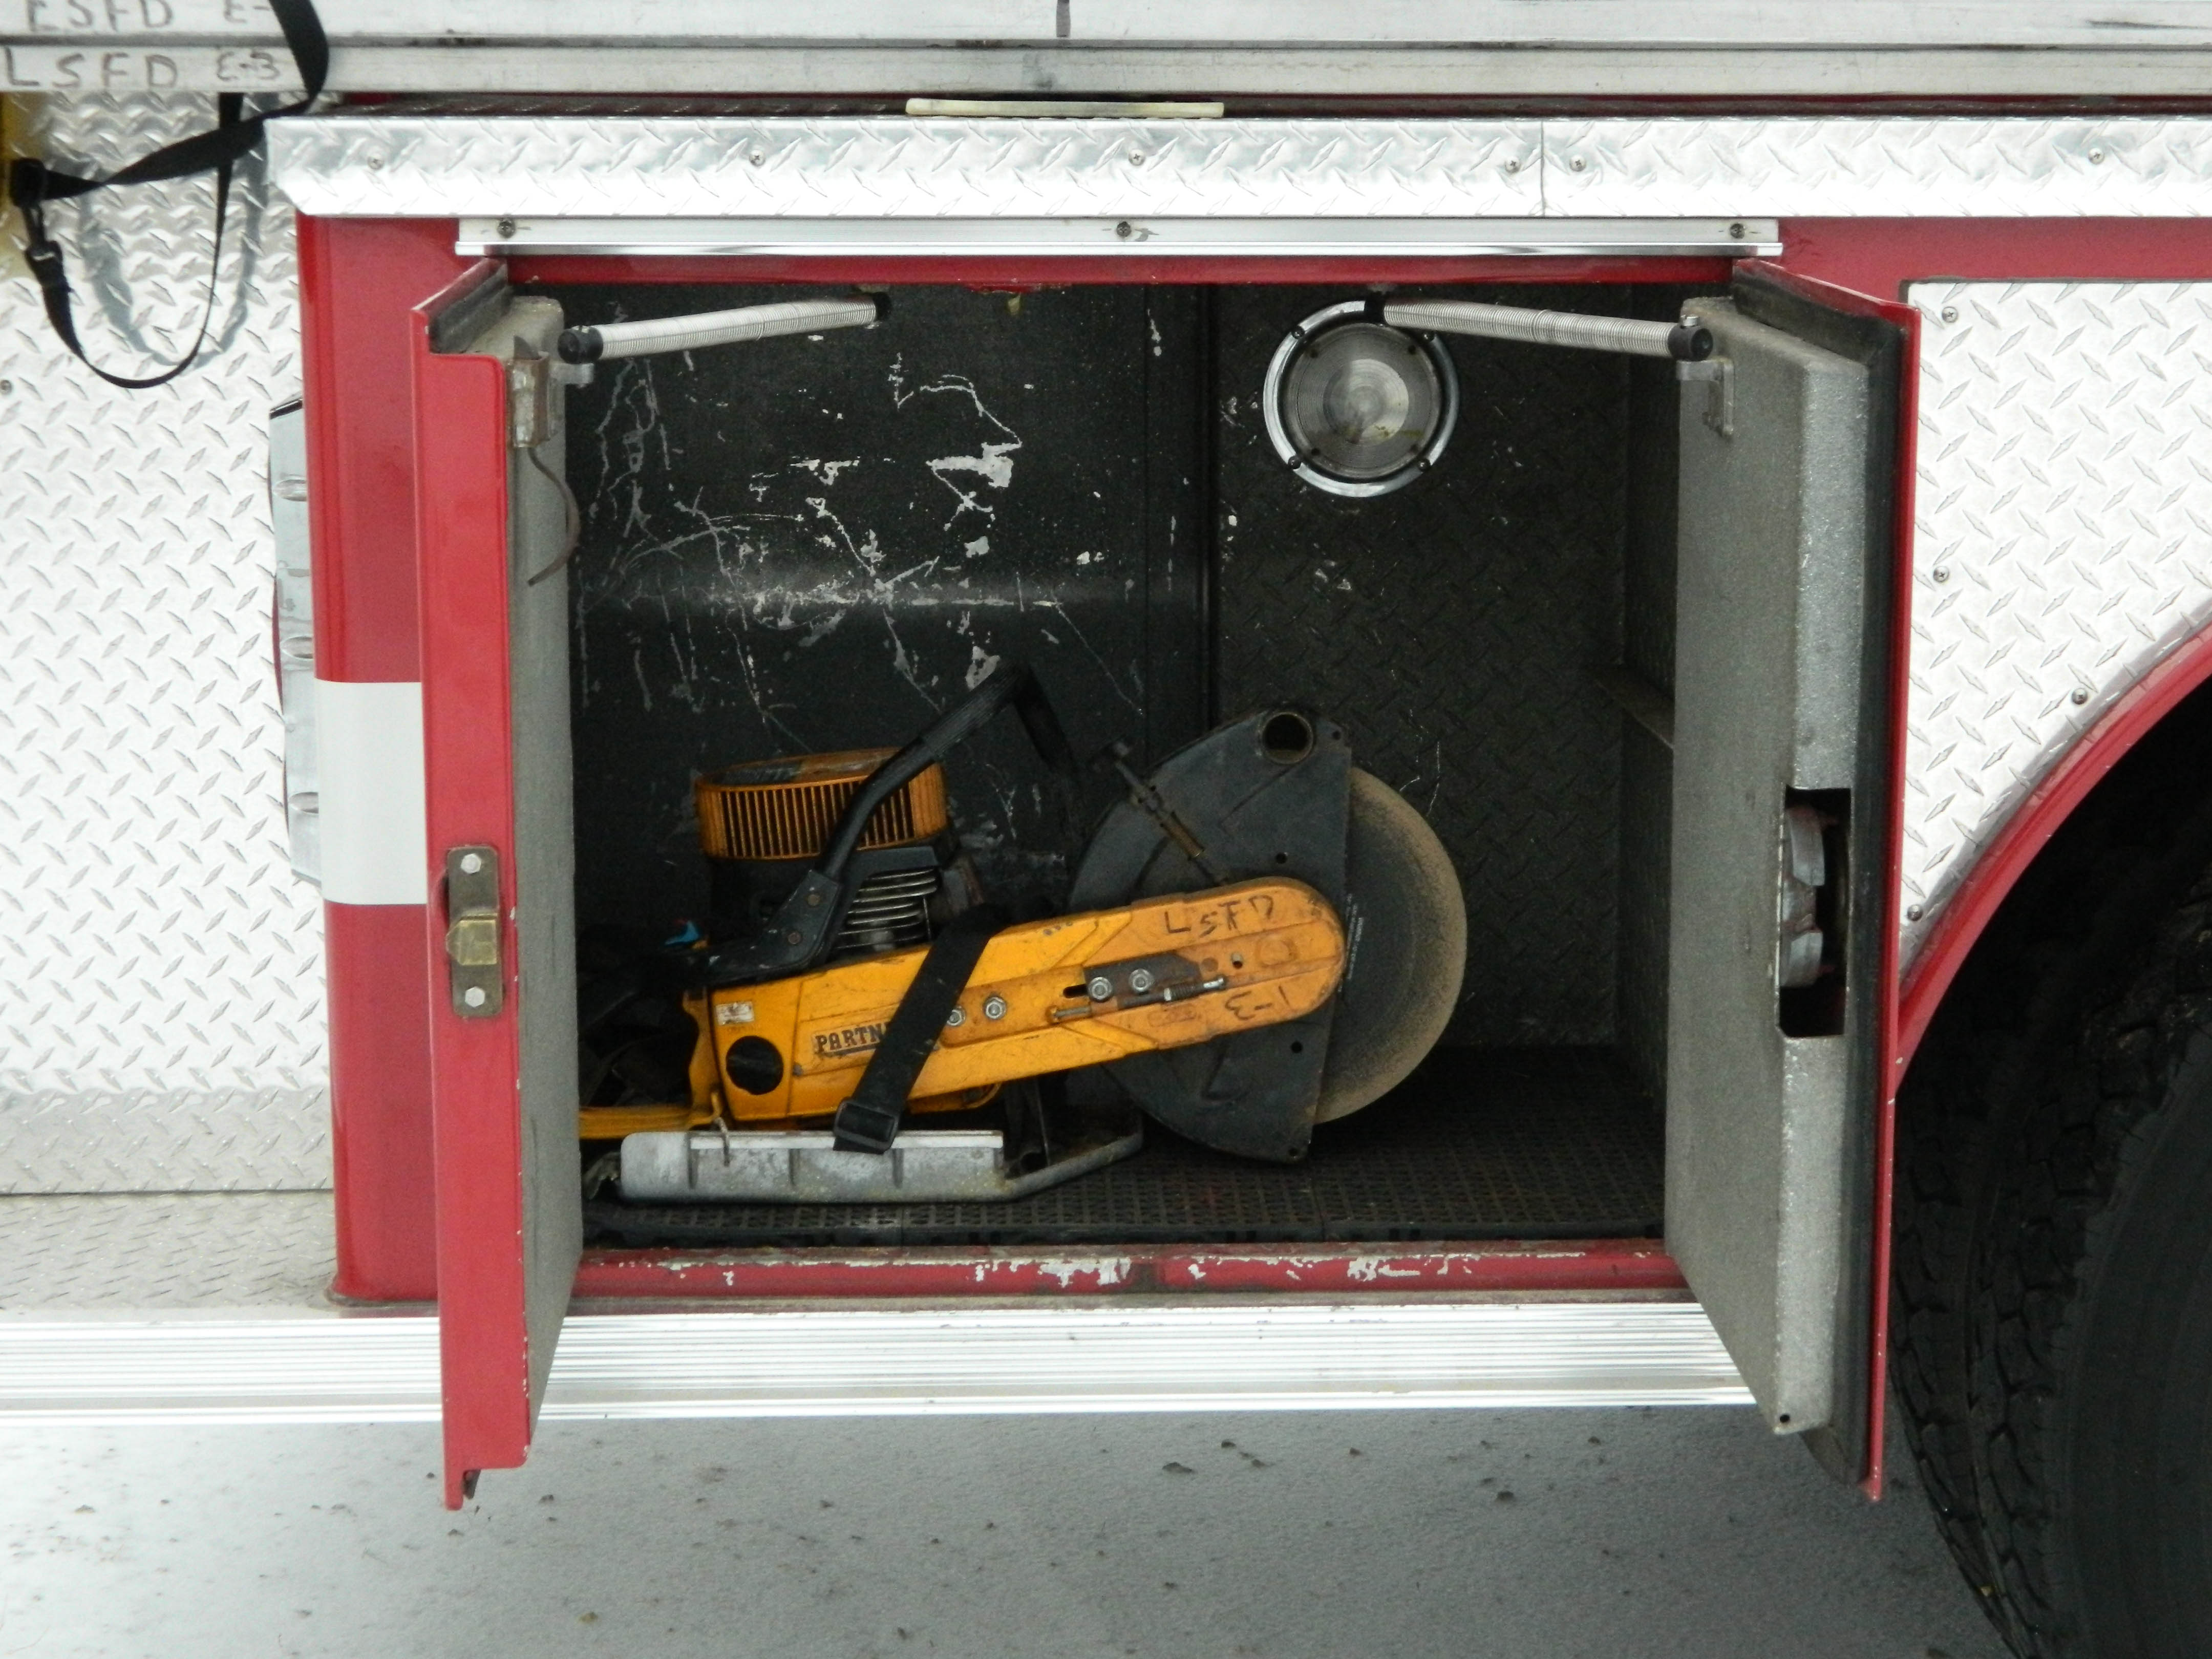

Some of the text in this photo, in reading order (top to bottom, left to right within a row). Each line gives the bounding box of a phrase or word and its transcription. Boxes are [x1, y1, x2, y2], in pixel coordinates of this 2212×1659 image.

[223, 0, 272, 24] E-
[5, 47, 281, 88] LSFD E-3
[815, 1022, 887, 1053] PARTN
